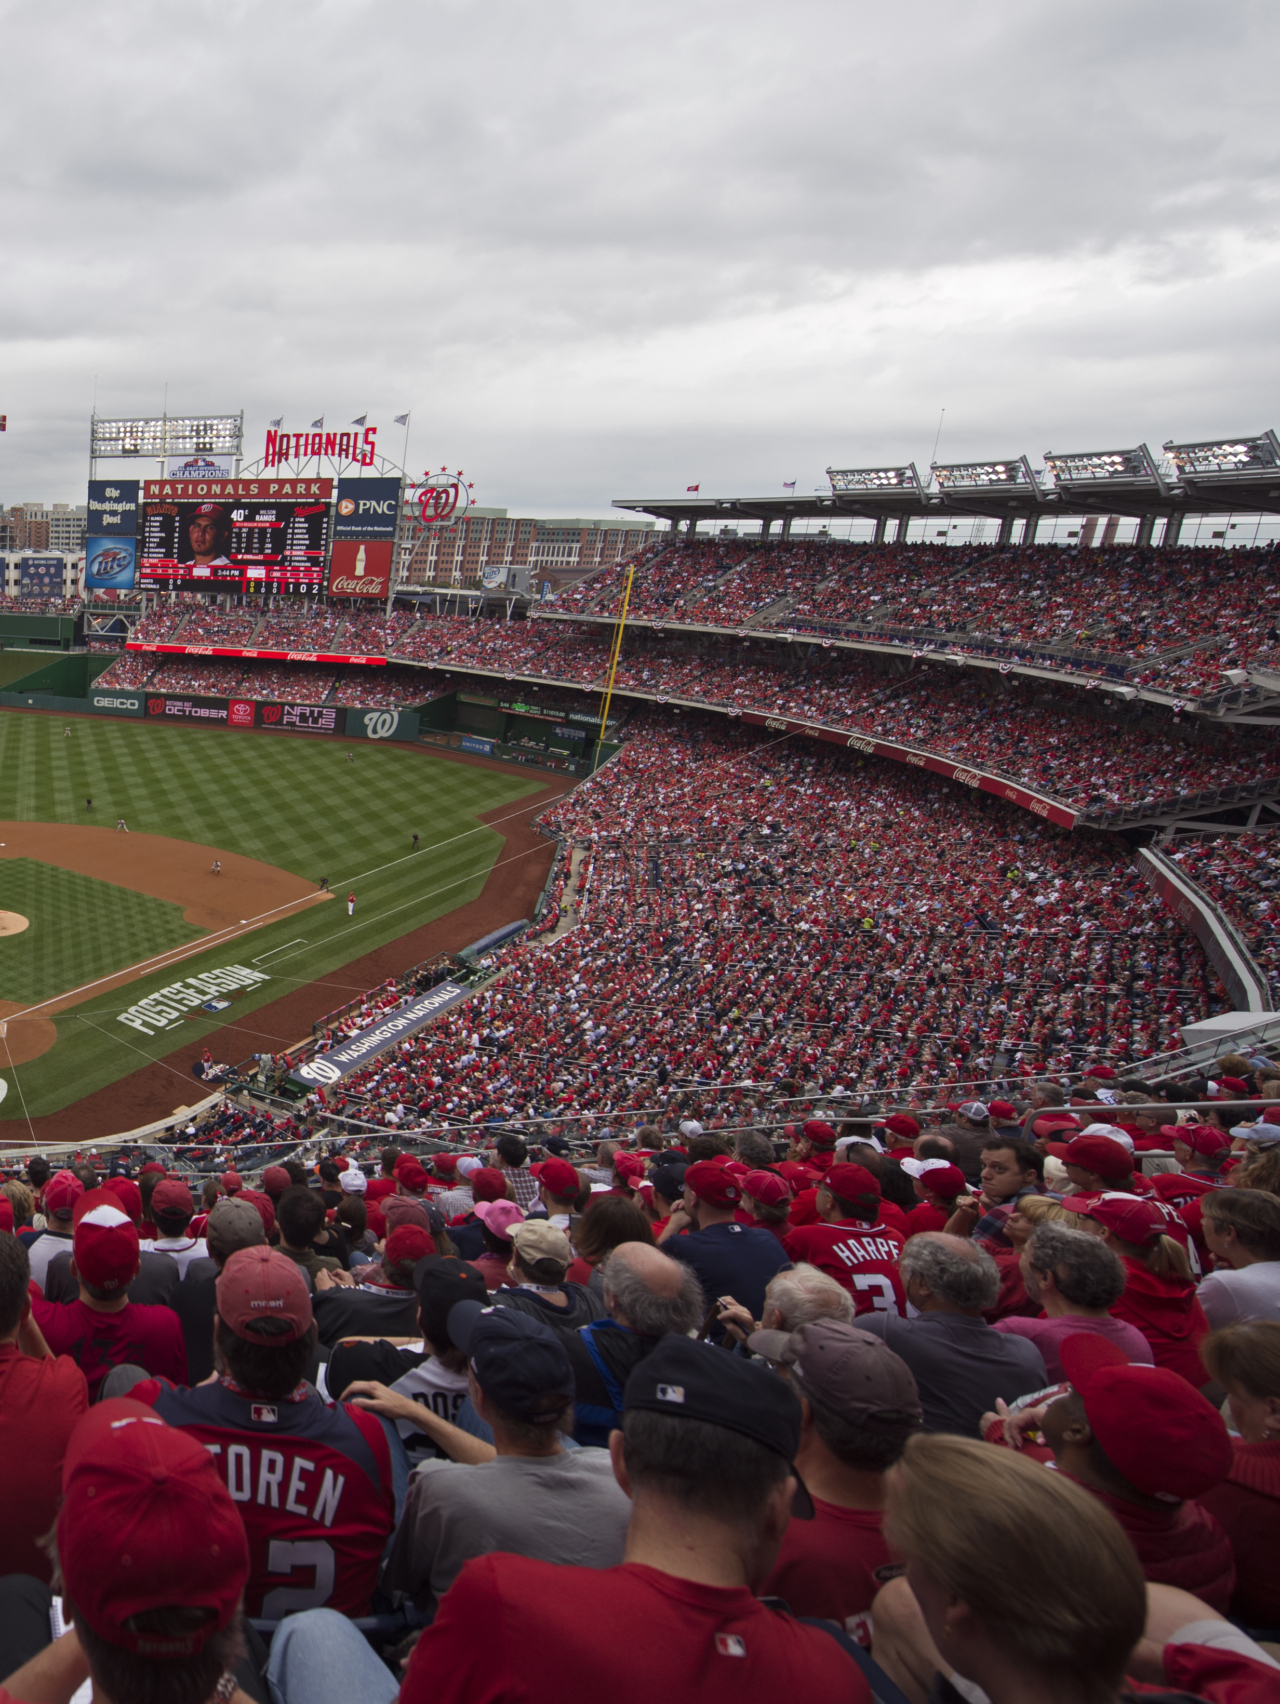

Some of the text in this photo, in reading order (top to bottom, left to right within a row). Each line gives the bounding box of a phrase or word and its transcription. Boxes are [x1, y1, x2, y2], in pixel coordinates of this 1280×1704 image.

[265, 427, 377, 467] NATIONALS
[169, 470, 229, 478] CHAMPIONS
[104, 487, 120, 498] The
[150, 482, 322, 496] NATIONALS PARK
[89, 499, 136, 513] Washington
[358, 500, 396, 515] PNC
[102, 514, 122, 526] Post
[230, 510, 244, 521] 40
[255, 514, 276, 522] RAMOS
[289, 584, 319, 594] 1 0 2
[332, 576, 386, 594] Coca-Cola
[94, 697, 139, 710] GEICO
[165, 705, 228, 719] OCTOBER
[284, 705, 337, 718] NATS
[282, 715, 336, 728] PLUS
[116, 964, 272, 1036] POSTSEASON
[333, 986, 461, 1063] WASHINGTON NATIONALS
